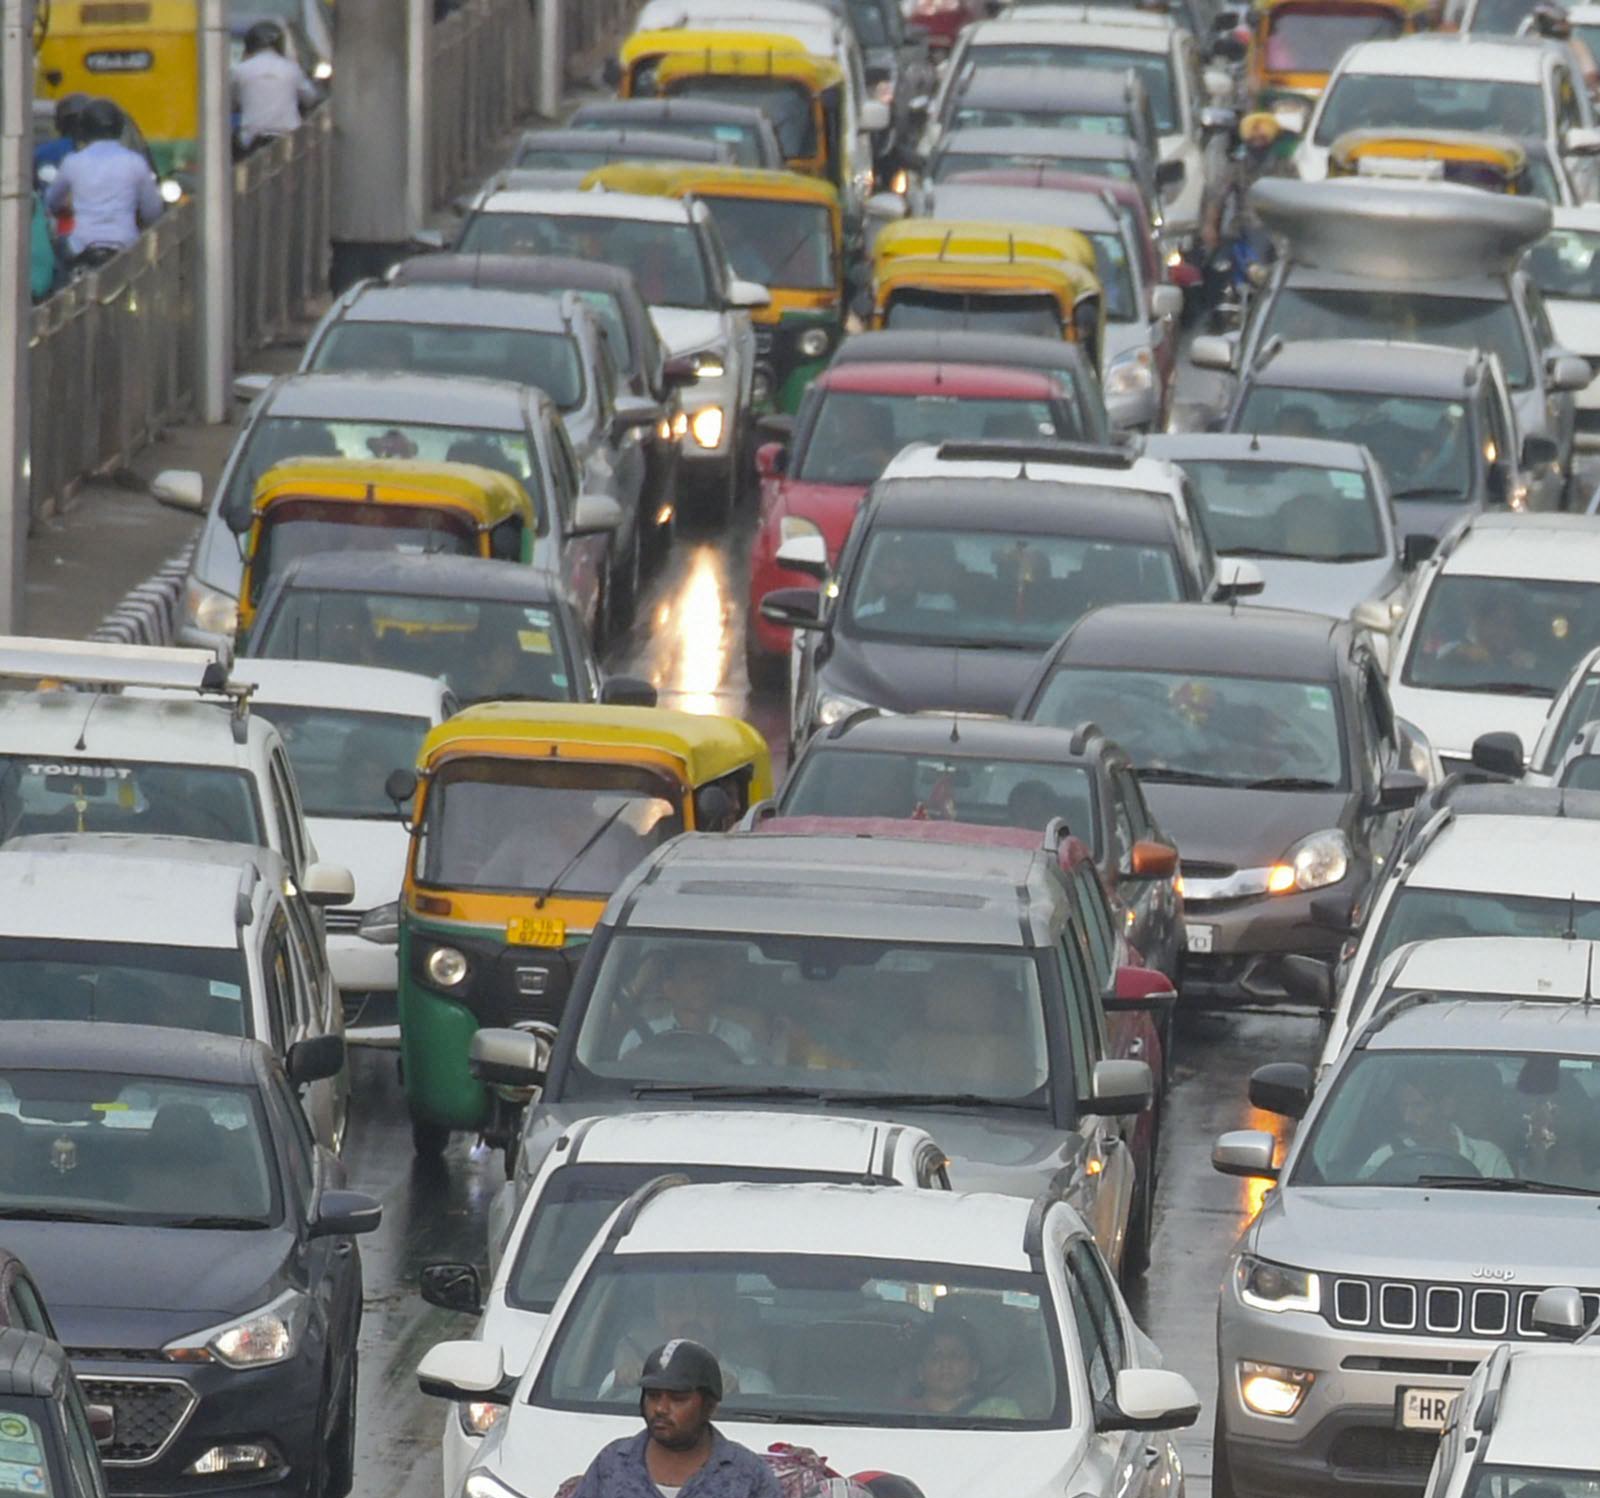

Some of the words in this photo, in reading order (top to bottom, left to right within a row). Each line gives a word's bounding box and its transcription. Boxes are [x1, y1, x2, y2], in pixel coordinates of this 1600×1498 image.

[27, 764, 132, 779] TOURIST
[1472, 1266, 1514, 1281] Jeep
[1419, 1399, 1446, 1422] HR
